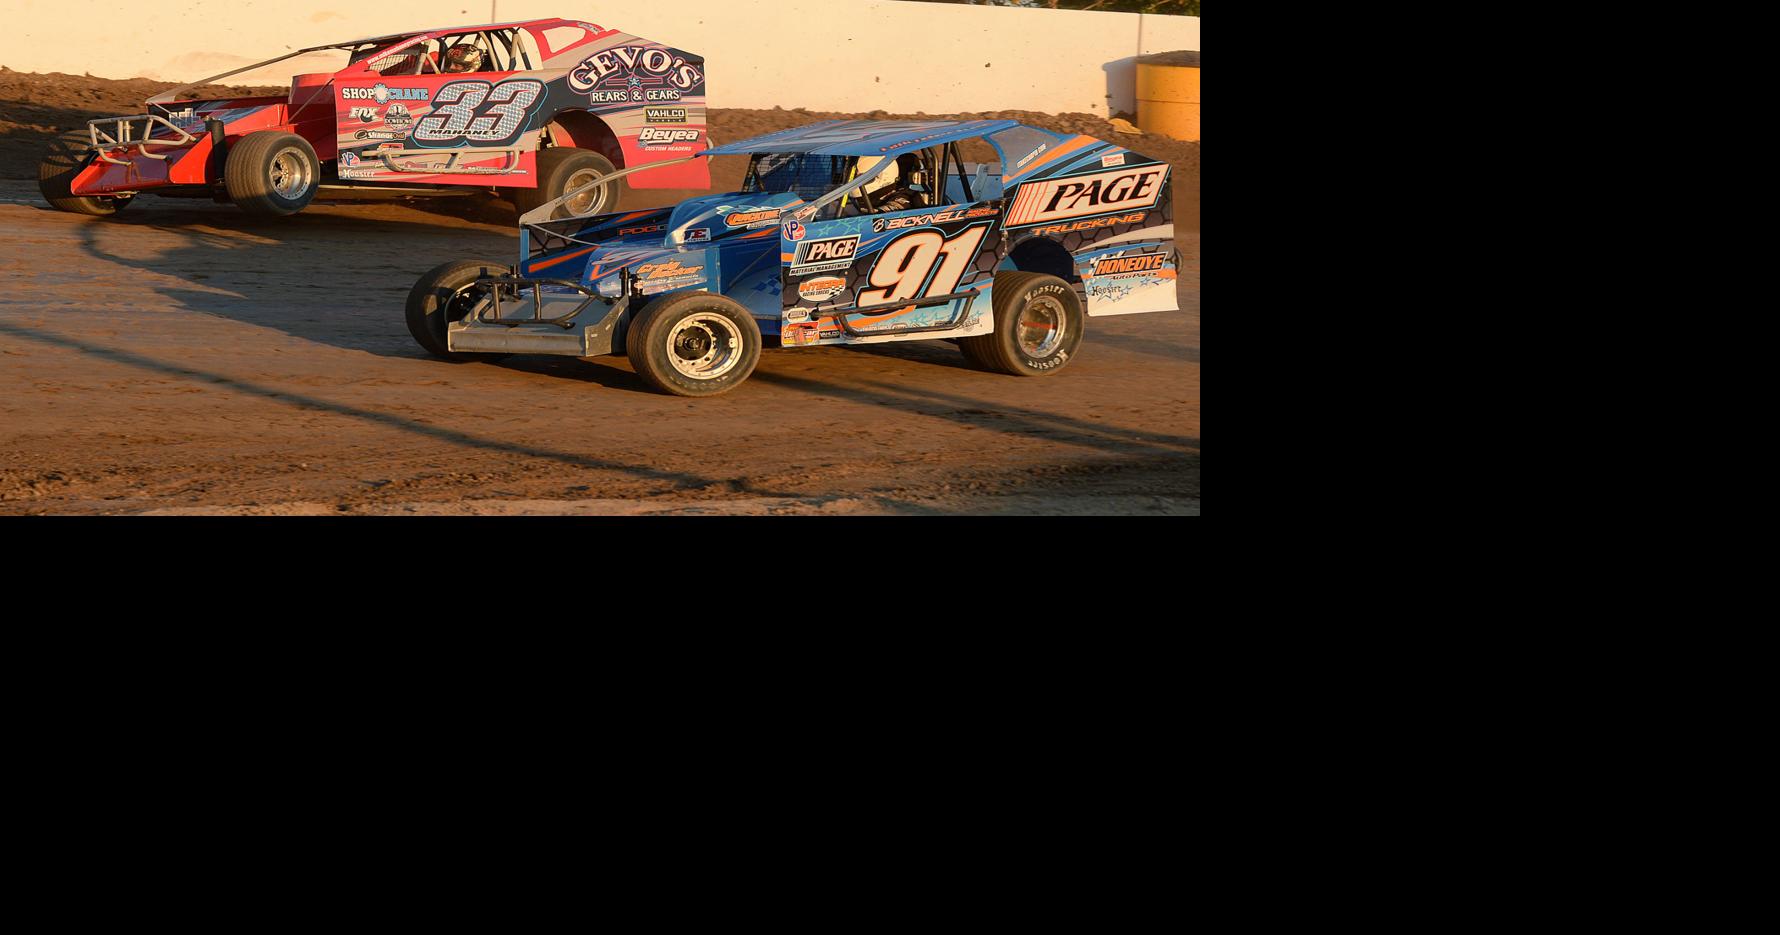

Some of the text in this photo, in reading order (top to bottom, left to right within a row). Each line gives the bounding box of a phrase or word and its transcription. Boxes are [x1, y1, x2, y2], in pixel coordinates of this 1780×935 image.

[569, 46, 701, 90] GEVO'S
[342, 88, 429, 100] SHOP CRANE
[592, 90, 680, 102] REARS & GEARS
[349, 106, 380, 121] FOX
[413, 81, 544, 141] 33
[647, 109, 685, 117] VAHLCO
[639, 127, 699, 145] Beyea
[342, 169, 375, 178] Hoosier
[1043, 171, 1160, 213] PAGE
[886, 210, 966, 229] BICKNELL
[1032, 213, 1145, 236] TRUCKING
[807, 239, 857, 261] PAGE
[816, 262, 850, 272] MANAGEMENT
[857, 226, 987, 309] 91
[1096, 255, 1165, 275] HONEOYE
[1024, 284, 1065, 303] Hoosier
[1092, 285, 1121, 296] Hoosier
